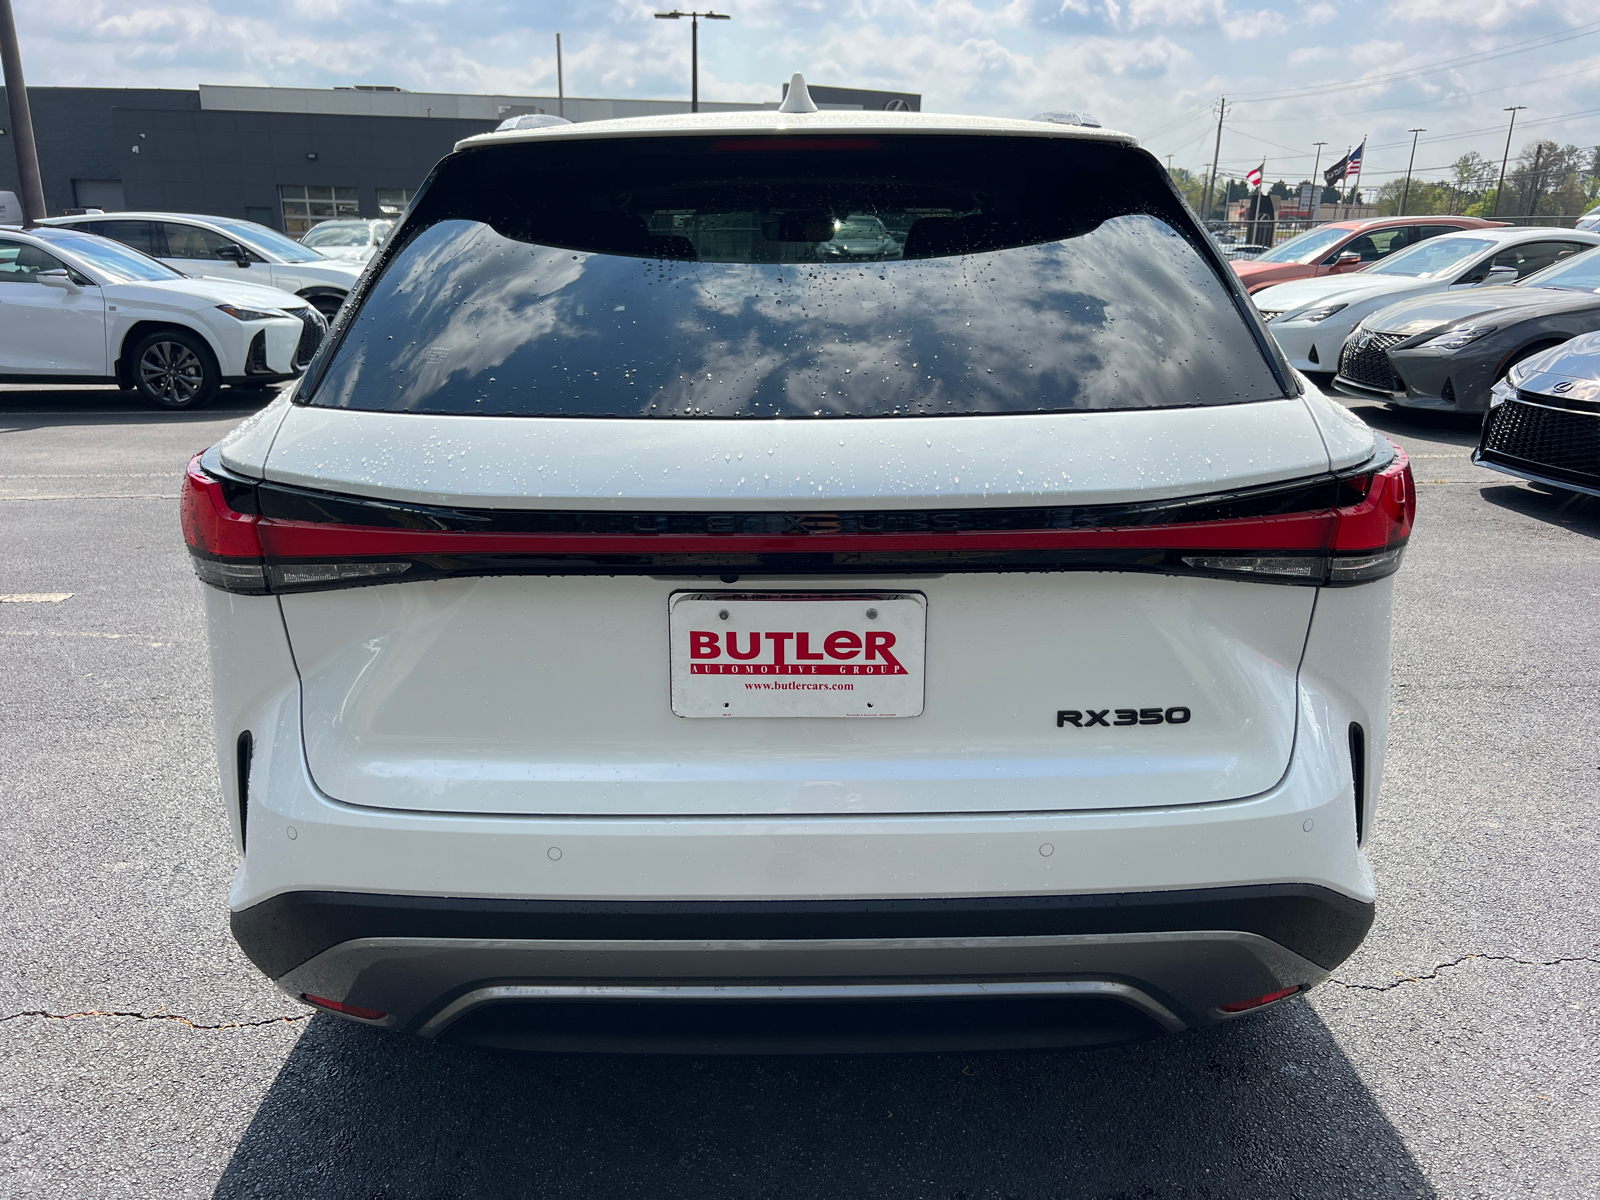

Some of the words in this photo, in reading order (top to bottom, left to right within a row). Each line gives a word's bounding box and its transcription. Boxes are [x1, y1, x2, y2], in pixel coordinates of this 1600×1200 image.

[633, 514, 960, 533] LEXUS
[692, 665, 817, 674] AUTOMOTIVE
[840, 665, 900, 674] GROUP
[745, 681, 854, 691] www.butlercars.com
